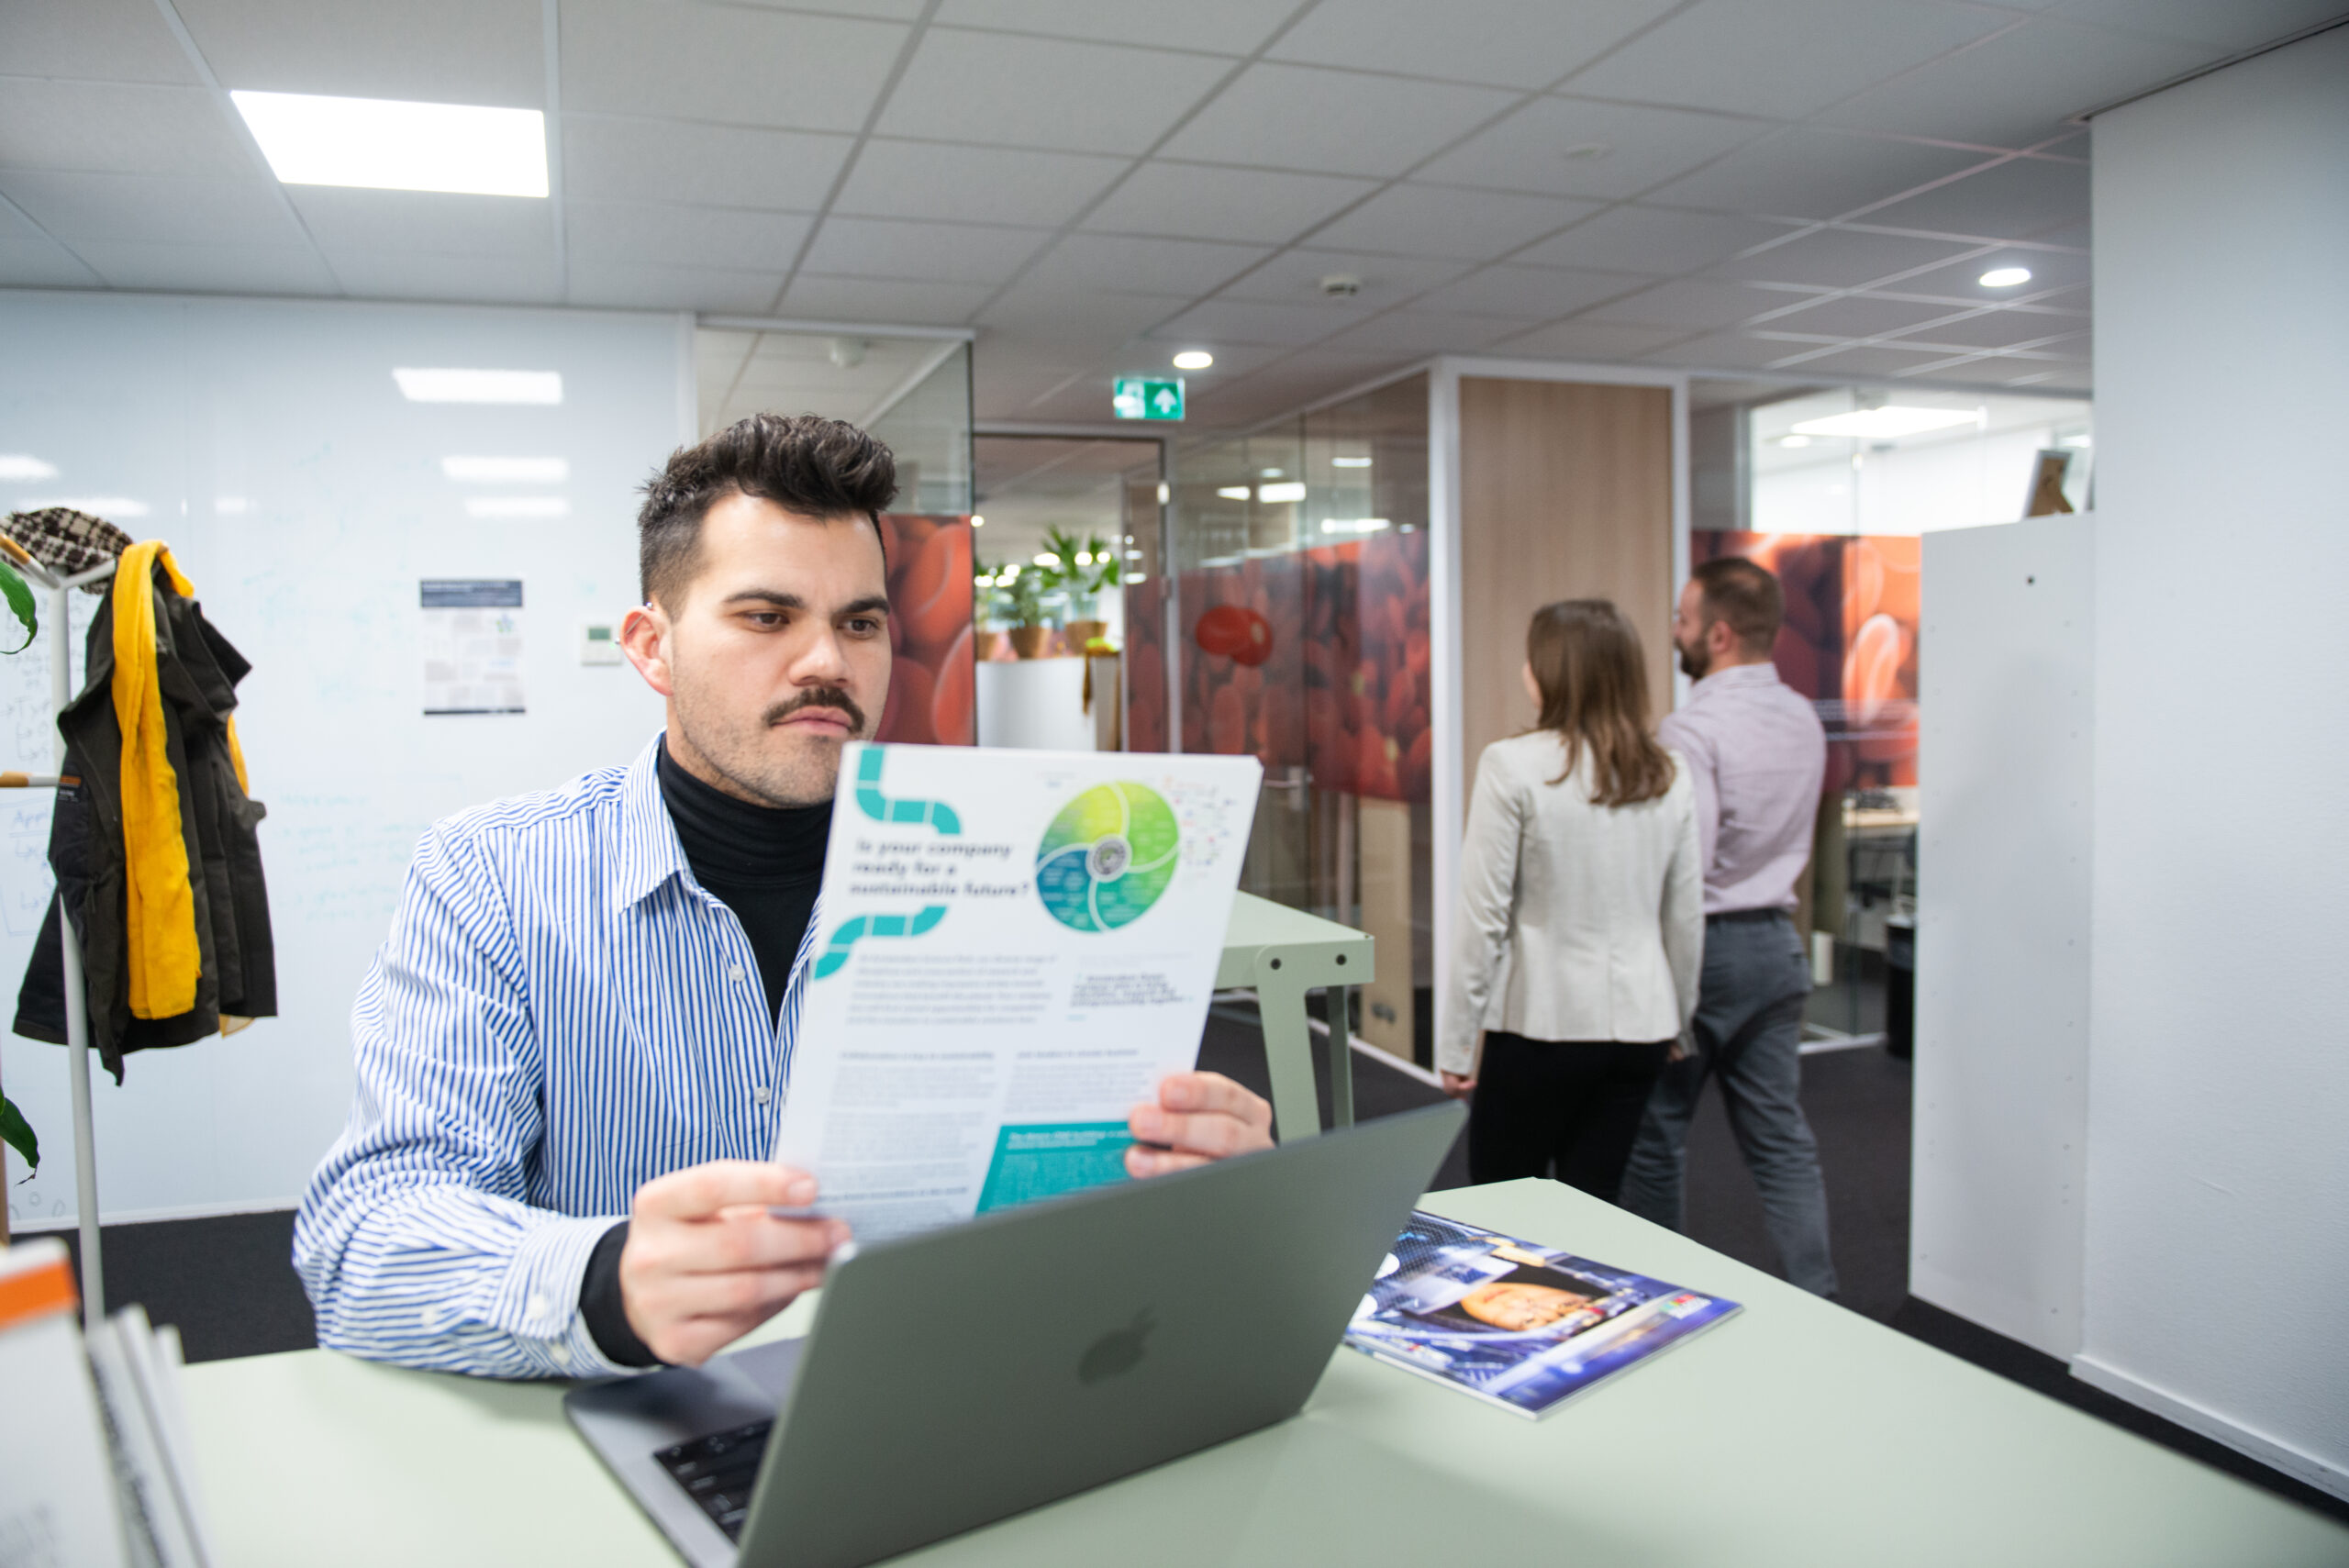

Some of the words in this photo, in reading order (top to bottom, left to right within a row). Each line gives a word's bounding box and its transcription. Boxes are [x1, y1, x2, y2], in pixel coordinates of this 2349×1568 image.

[856, 839, 872, 851] Is
[878, 843, 920, 857] your
[928, 843, 1012, 859] company
[852, 862, 907, 878] ready
[913, 861, 940, 874] for
[946, 866, 957, 875] a
[850, 881, 957, 895] sustainable
[963, 880, 1030, 896] future?
